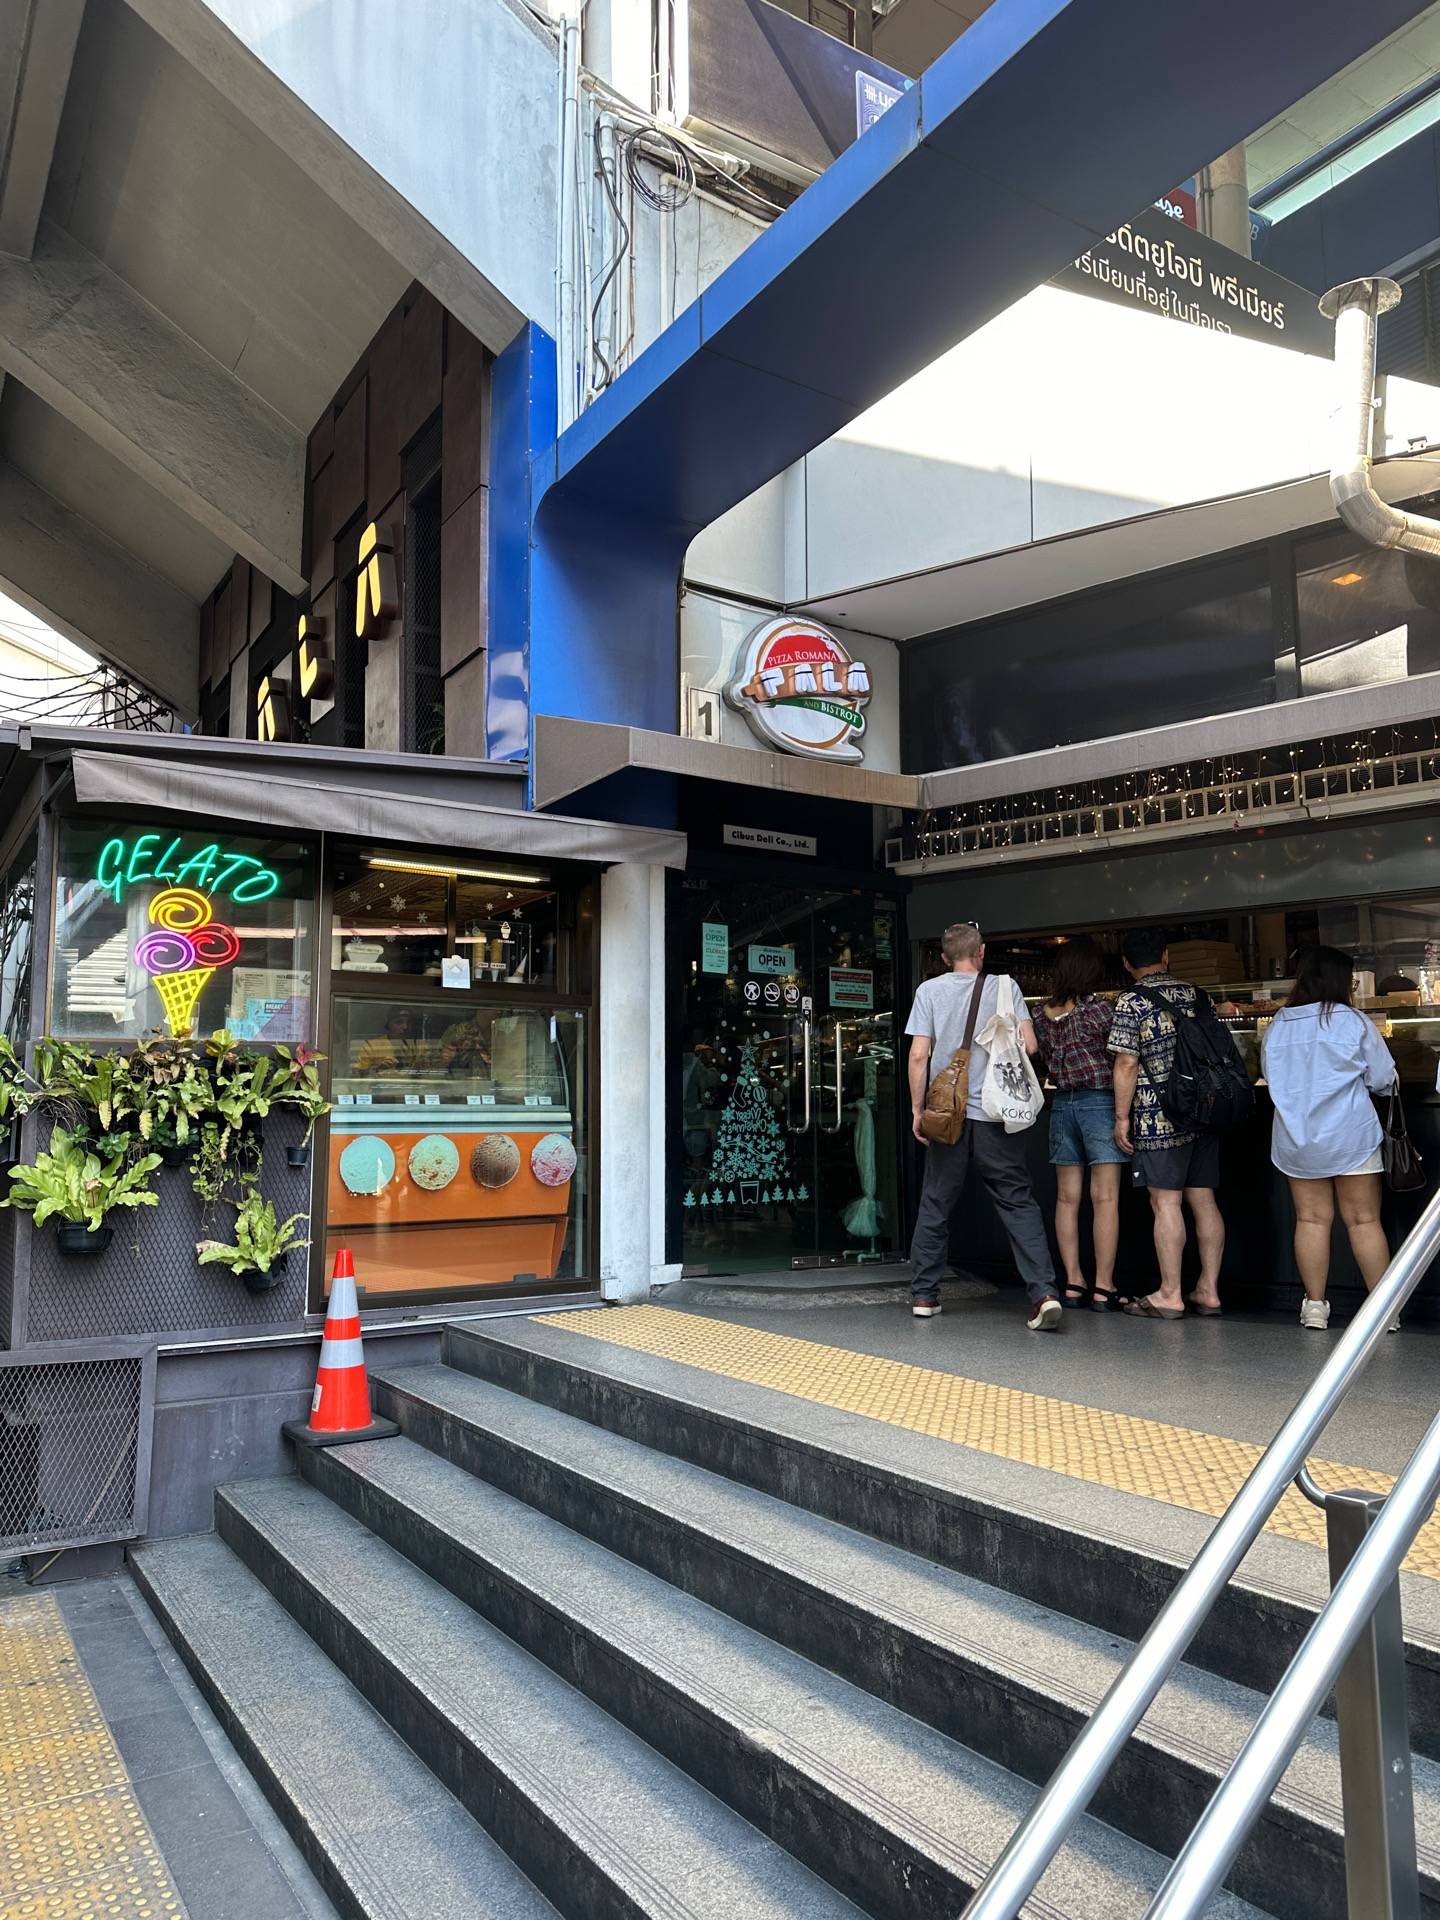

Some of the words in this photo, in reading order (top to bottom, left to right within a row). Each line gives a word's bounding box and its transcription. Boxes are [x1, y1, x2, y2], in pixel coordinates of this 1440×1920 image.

[1209, 273, 1285, 329] พรีเมียร์
[761, 661, 870, 697] PALA
[698, 701, 712, 736] 1
[821, 702, 859, 723] BISTROT
[731, 830, 755, 841] Cibus
[757, 834, 774, 844] Deli
[776, 837, 792, 848] Co.,
[794, 840, 810, 849] Ltd.
[97, 834, 278, 904] GELATO
[758, 953, 786, 967] OPEN
[1001, 1107, 1033, 1121] KOKO
